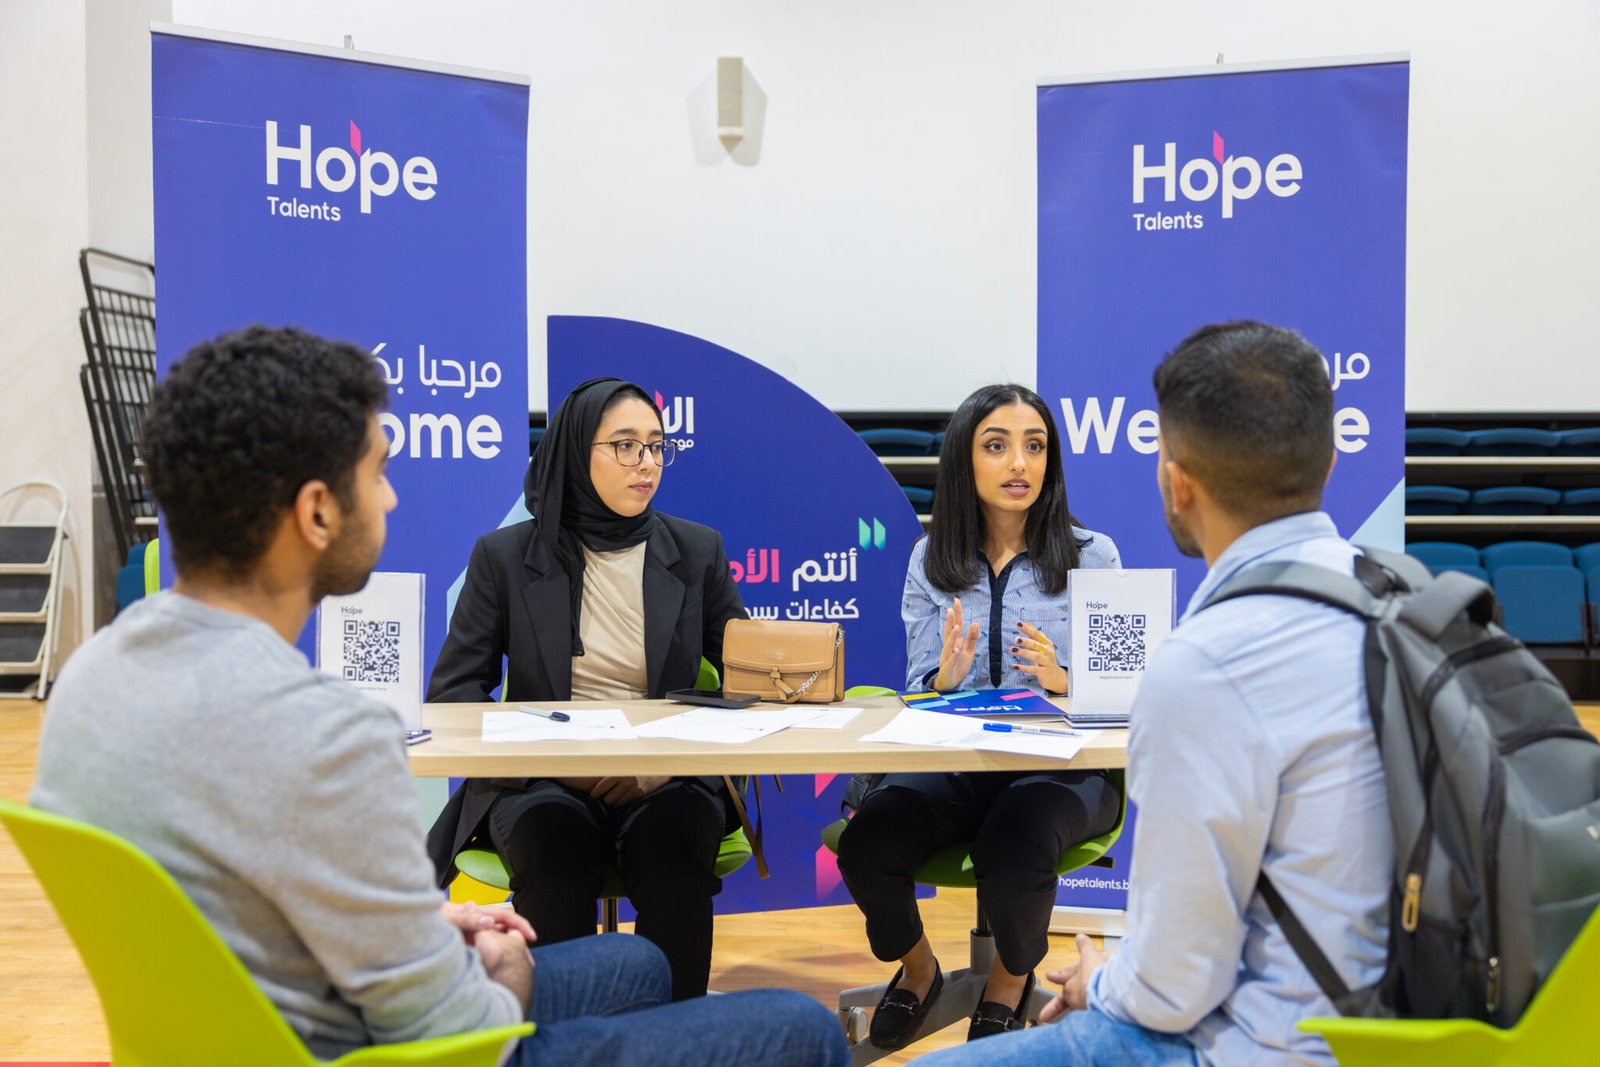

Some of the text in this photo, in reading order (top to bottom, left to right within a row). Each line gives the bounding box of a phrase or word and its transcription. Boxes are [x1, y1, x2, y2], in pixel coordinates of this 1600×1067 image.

[265, 119, 438, 214] Hope
[1132, 130, 1303, 219] Hope
[266, 196, 341, 221] Talents
[1132, 211, 1204, 231] Talents
[370, 342, 502, 398] مرحبا بك
[729, 547, 857, 592] أنتم الأم
[341, 605, 363, 615] Hope
[786, 598, 860, 620] كفاءات
[1086, 601, 1109, 611] Hope
[1058, 875, 1130, 891] hopetalents.b
